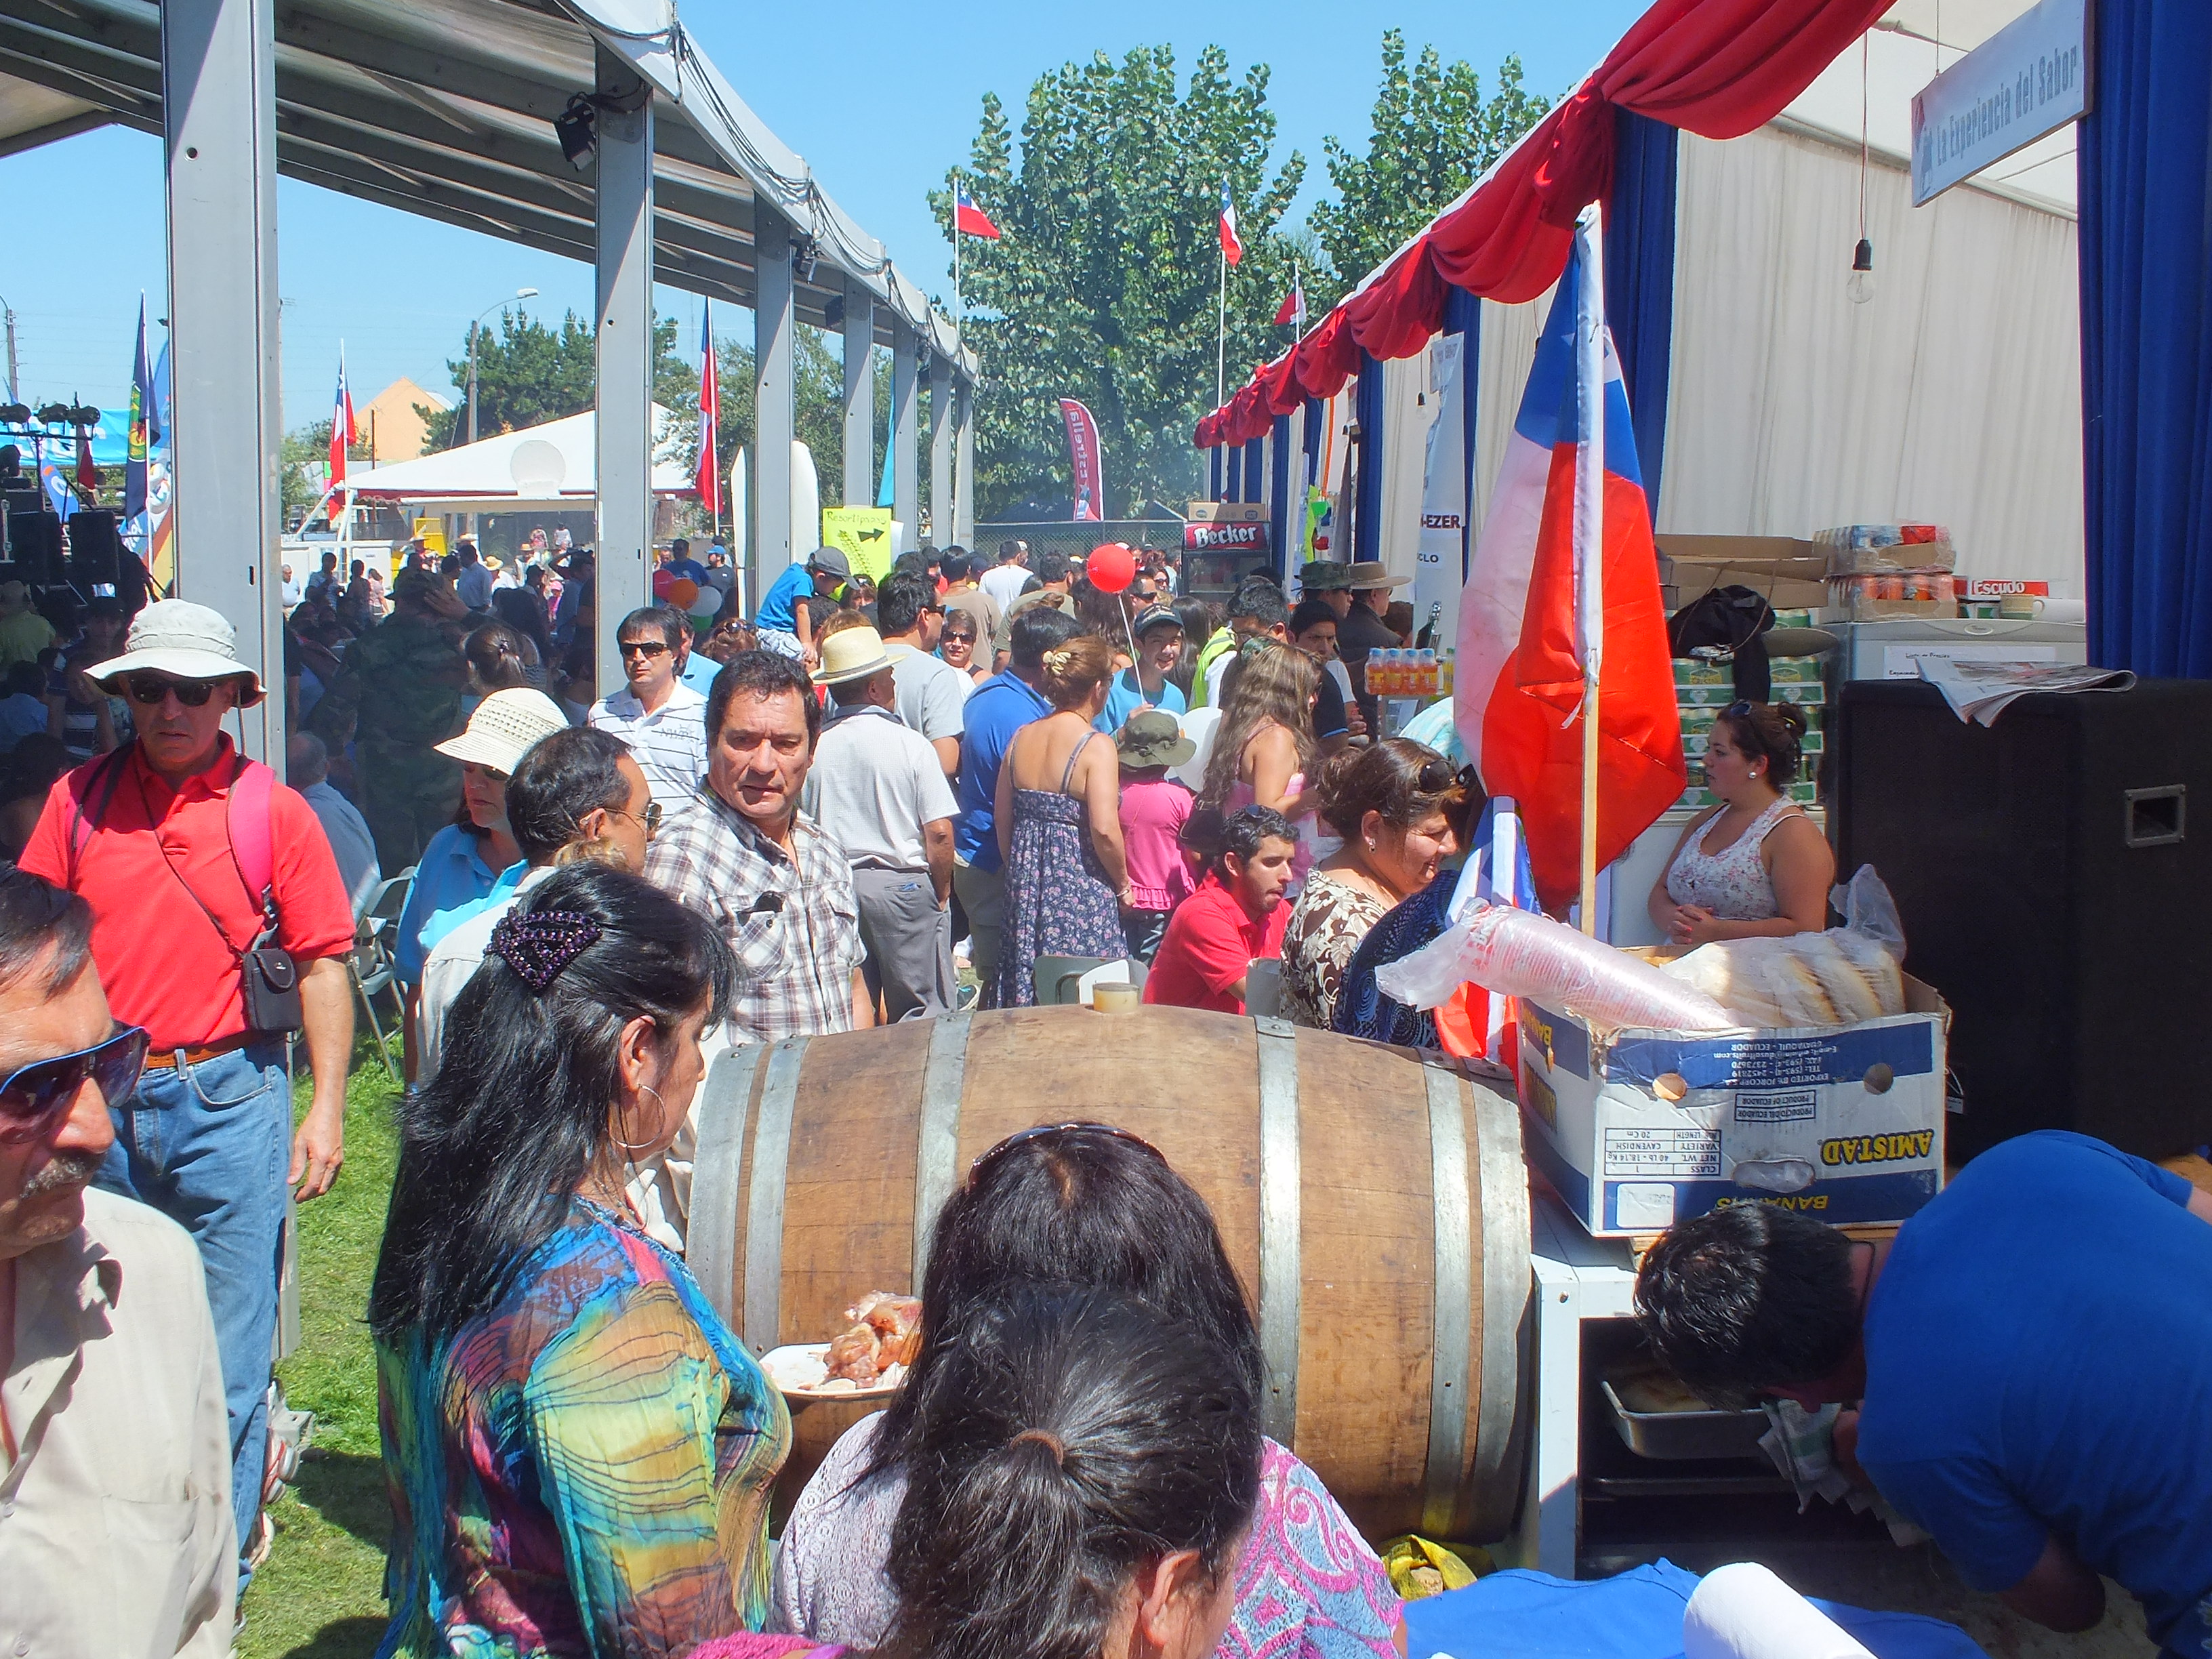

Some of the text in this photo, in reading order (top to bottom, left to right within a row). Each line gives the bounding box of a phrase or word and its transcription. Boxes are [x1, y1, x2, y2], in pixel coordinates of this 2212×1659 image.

[1938, 45, 2077, 166] La Experiencia del Sabor
[1194, 524, 1257, 548] Becker
[1790, 1073, 1828, 1083] EXPORTED
[1780, 1095, 1809, 1104] PRODUCT
[1780, 1107, 1812, 1118] PRODUCTO
[1822, 1129, 1933, 1166] AMISTAD
